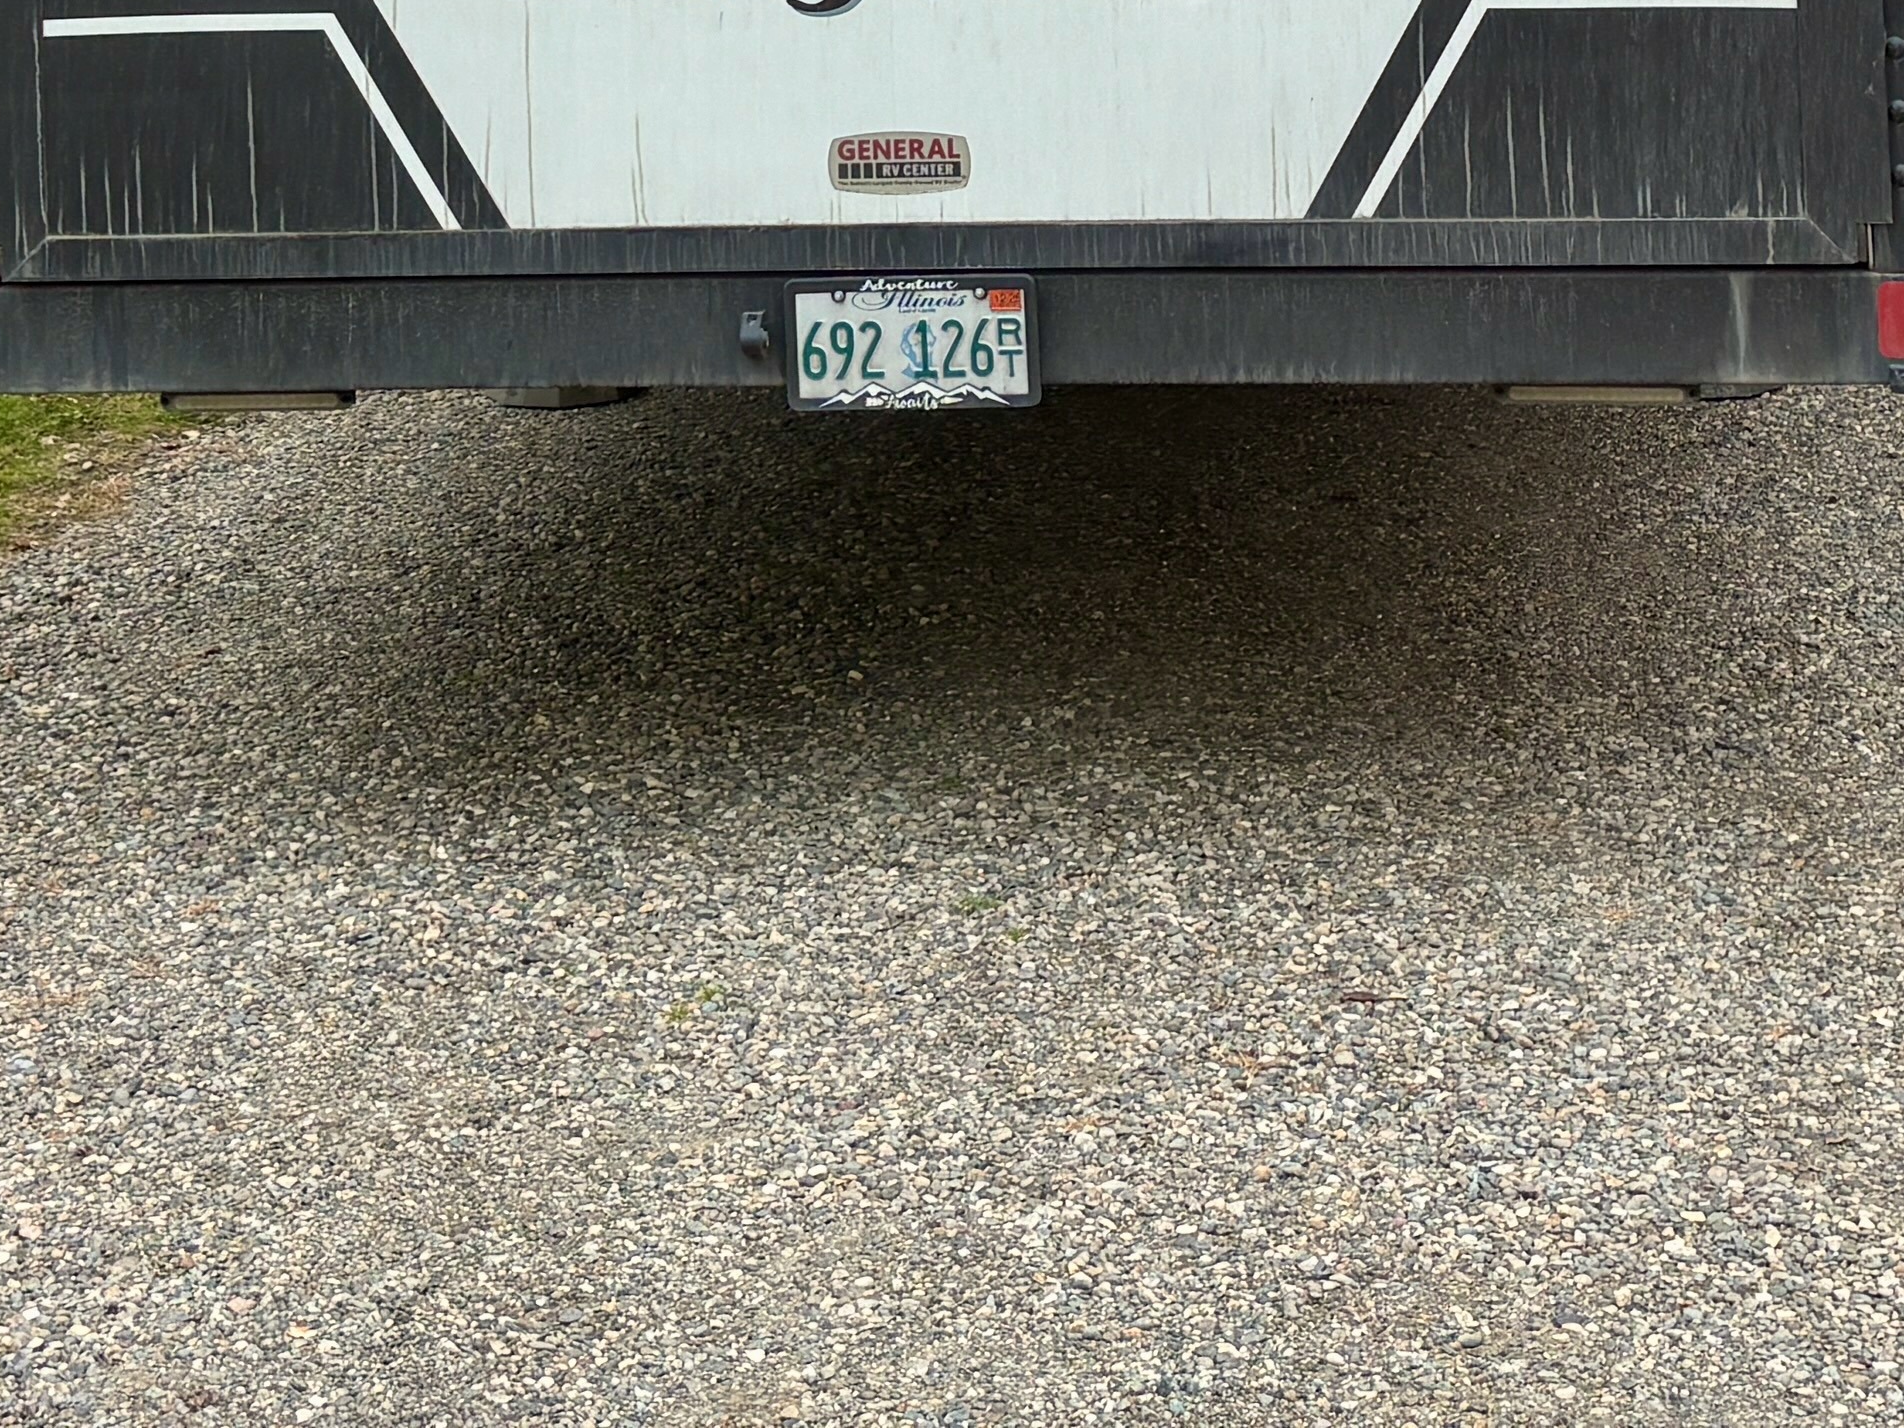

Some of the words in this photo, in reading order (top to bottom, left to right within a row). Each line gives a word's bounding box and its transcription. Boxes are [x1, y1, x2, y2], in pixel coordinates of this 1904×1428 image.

[837, 137, 961, 161] GENERAL
[882, 164, 900, 177] RV
[903, 163, 954, 177] CENTER
[859, 278, 958, 291] Adventure
[852, 290, 967, 311] Illinois
[802, 320, 886, 381] 692
[913, 317, 994, 379] 126
